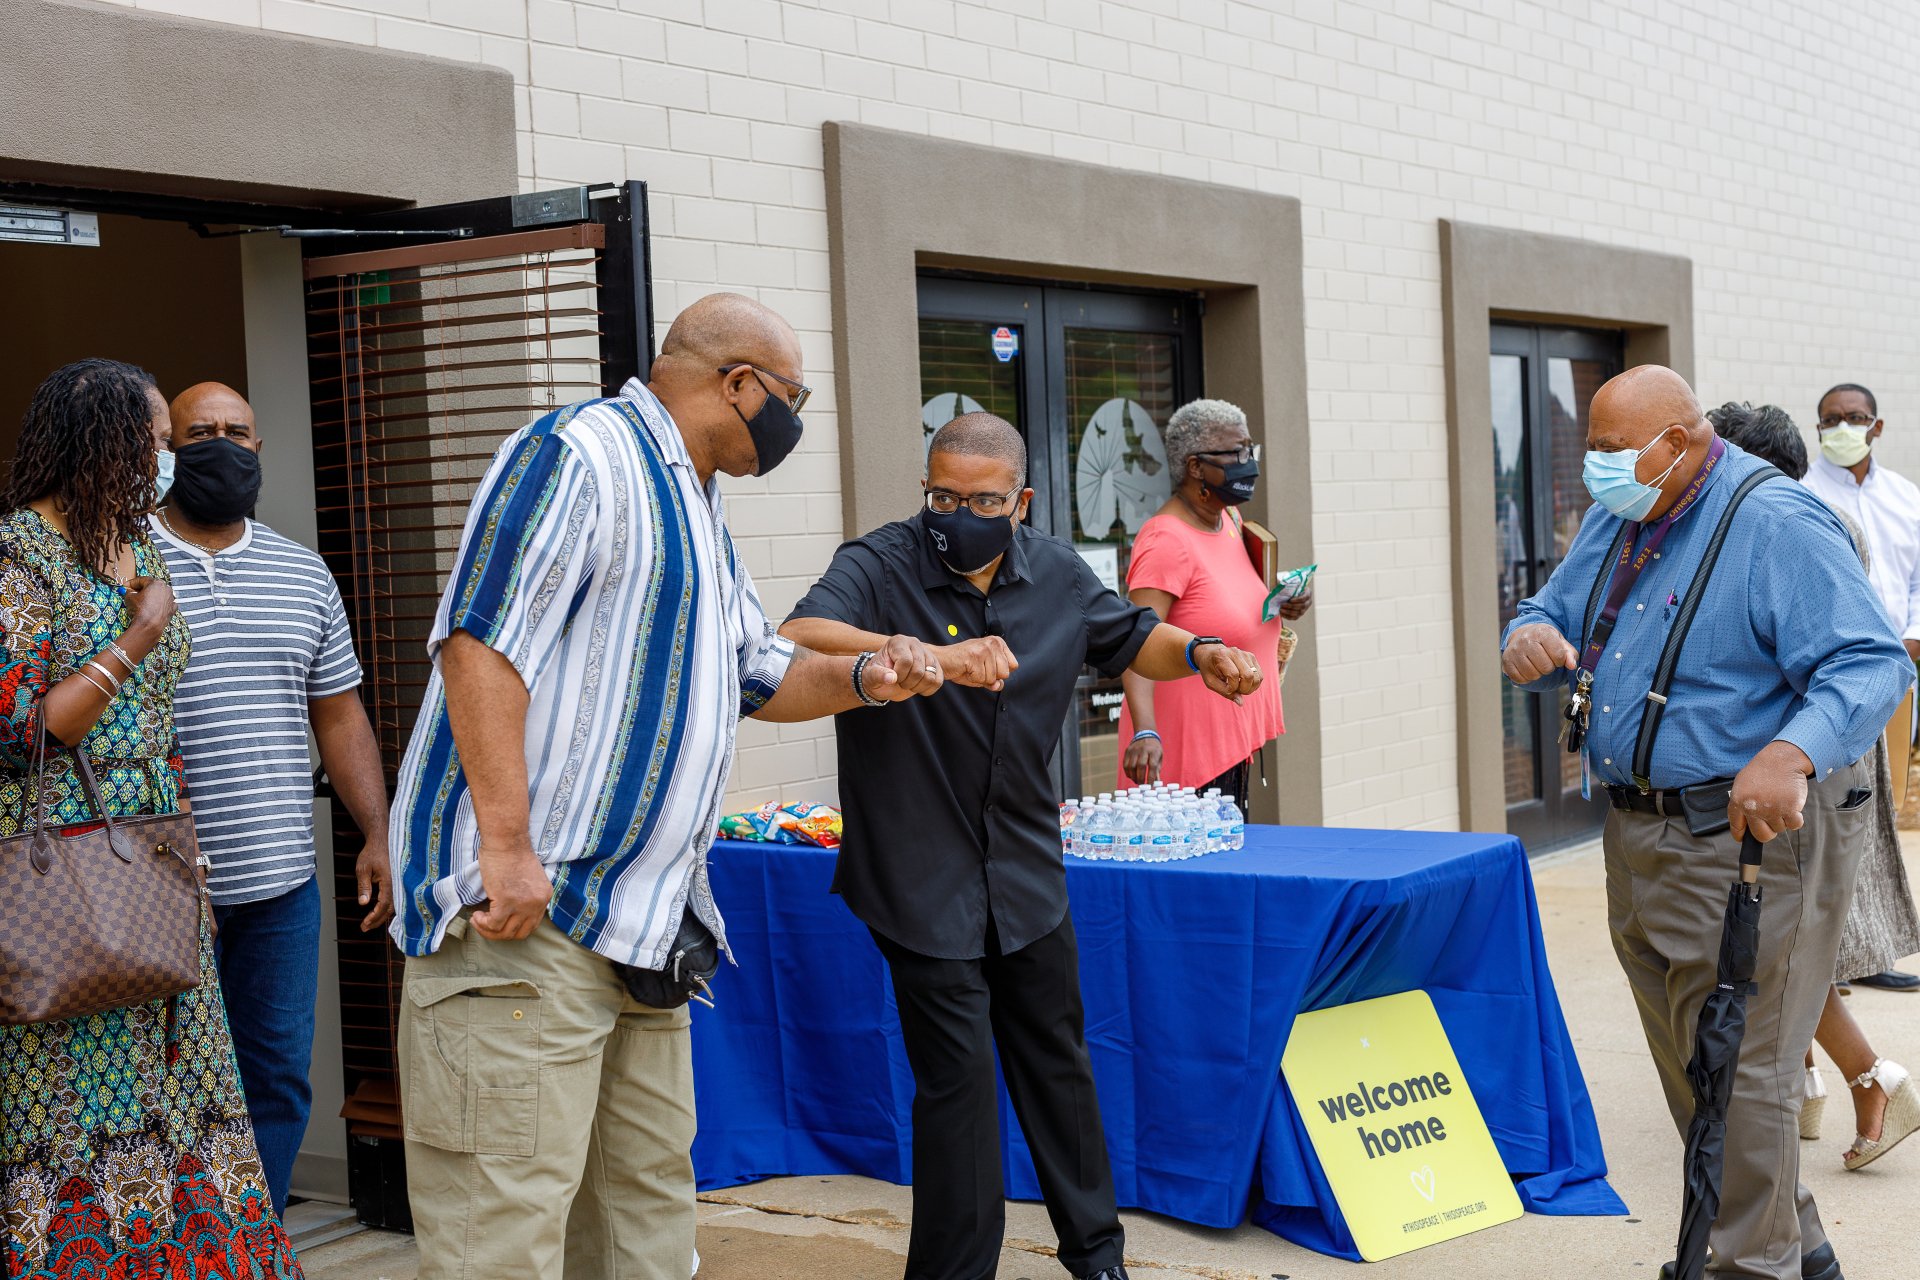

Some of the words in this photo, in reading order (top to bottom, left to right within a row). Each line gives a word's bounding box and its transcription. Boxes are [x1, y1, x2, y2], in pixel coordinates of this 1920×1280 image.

[1620, 540, 1632, 565] 1911
[1633, 547, 1652, 570] 1911
[1318, 1071, 1452, 1123] welcome
[1357, 1116, 1447, 1159] home
